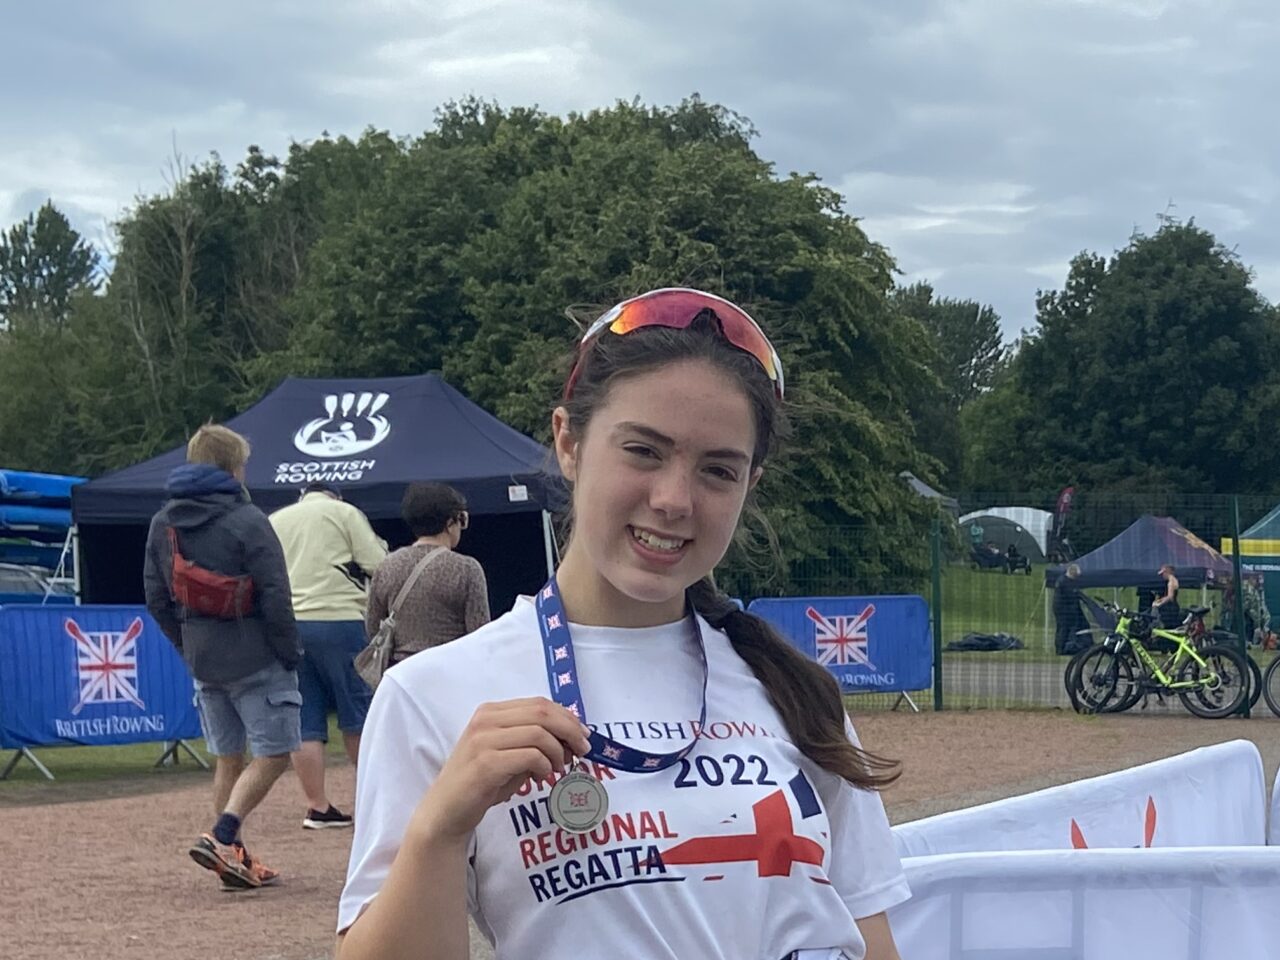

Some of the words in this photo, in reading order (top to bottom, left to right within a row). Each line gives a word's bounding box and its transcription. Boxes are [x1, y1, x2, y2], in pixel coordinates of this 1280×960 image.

[274, 471, 363, 483] ROWING
[275, 460, 376, 473] SCOTTISH
[674, 754, 777, 788] 2022
[519, 811, 678, 869] REGIONAL
[528, 845, 667, 902] REGATTA
